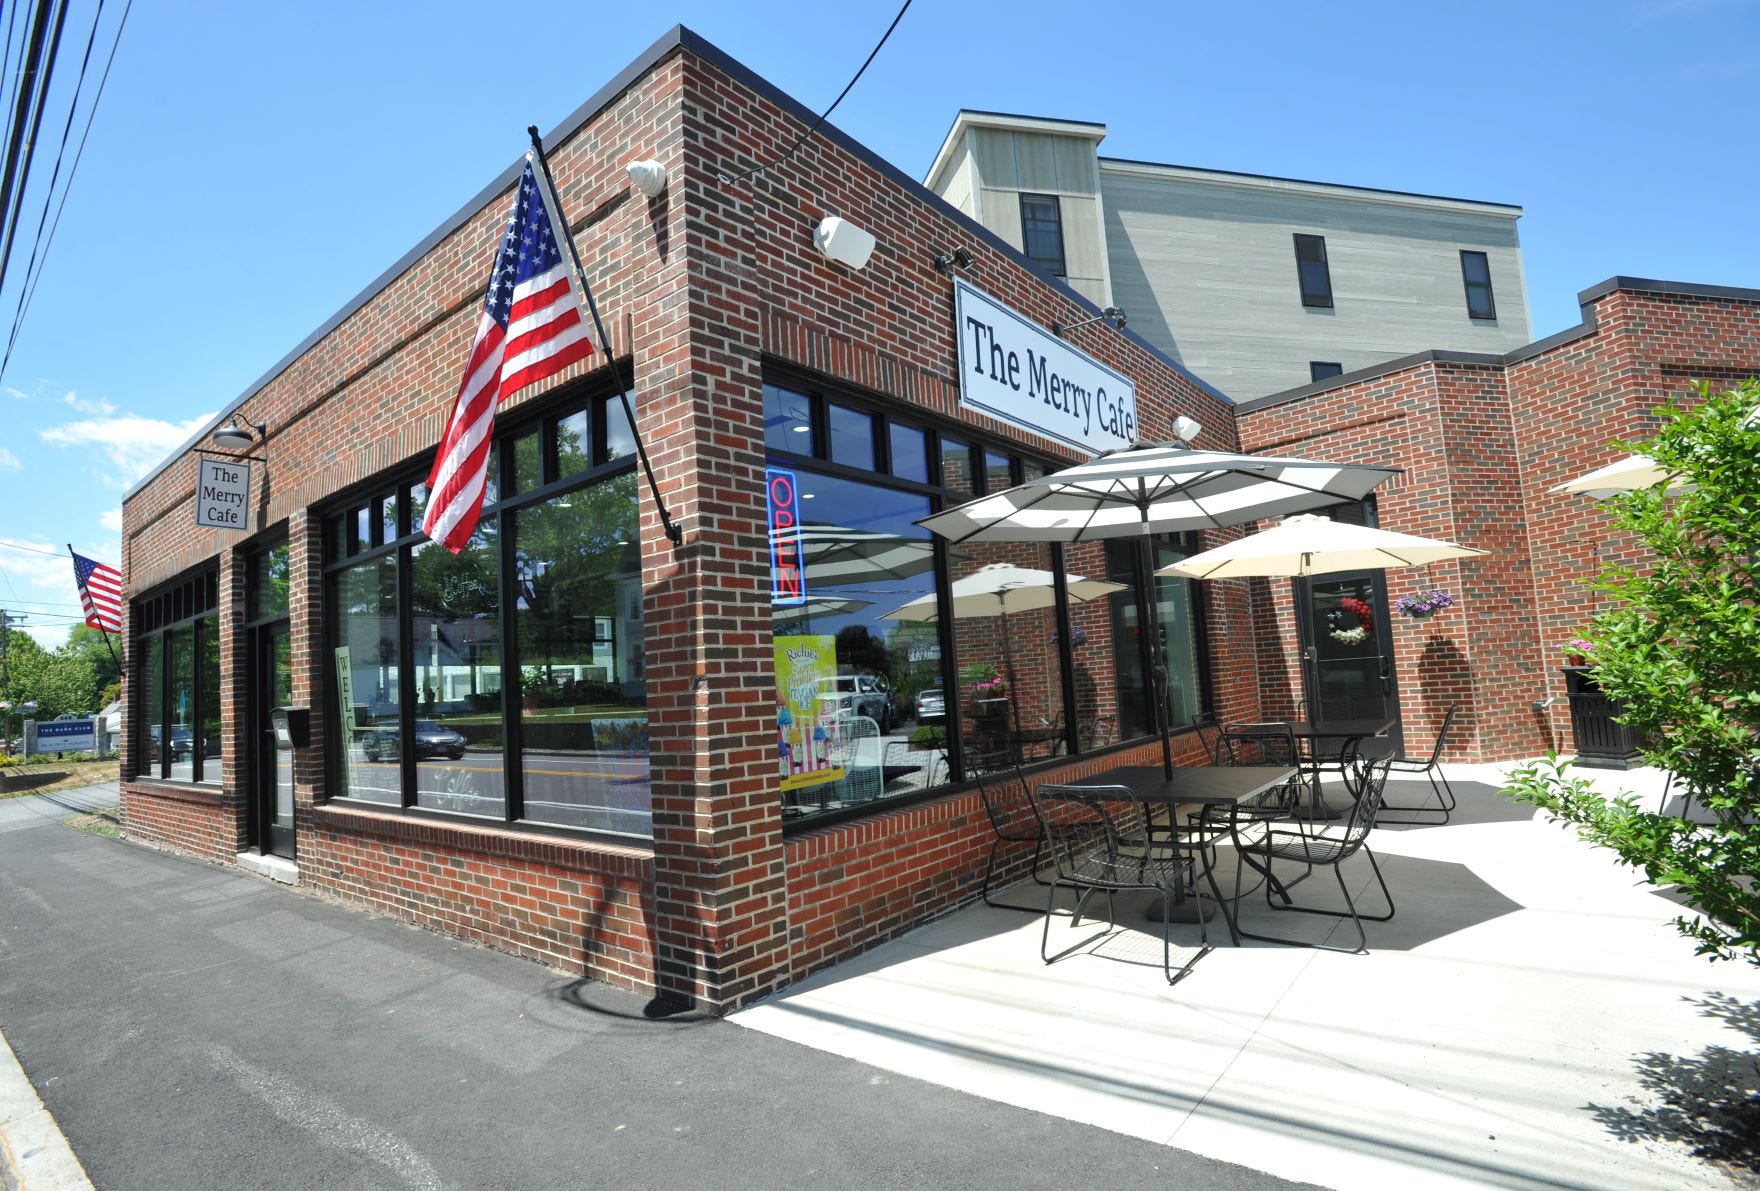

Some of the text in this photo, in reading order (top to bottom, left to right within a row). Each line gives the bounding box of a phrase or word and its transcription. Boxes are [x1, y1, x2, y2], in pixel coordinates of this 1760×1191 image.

[967, 315, 1135, 443] The Merry Cafe
[212, 467, 239, 483] The
[202, 486, 246, 507] Merry
[208, 507, 238, 523] Cafe
[771, 477, 799, 598] OPEN
[786, 642, 819, 662] Richie's
